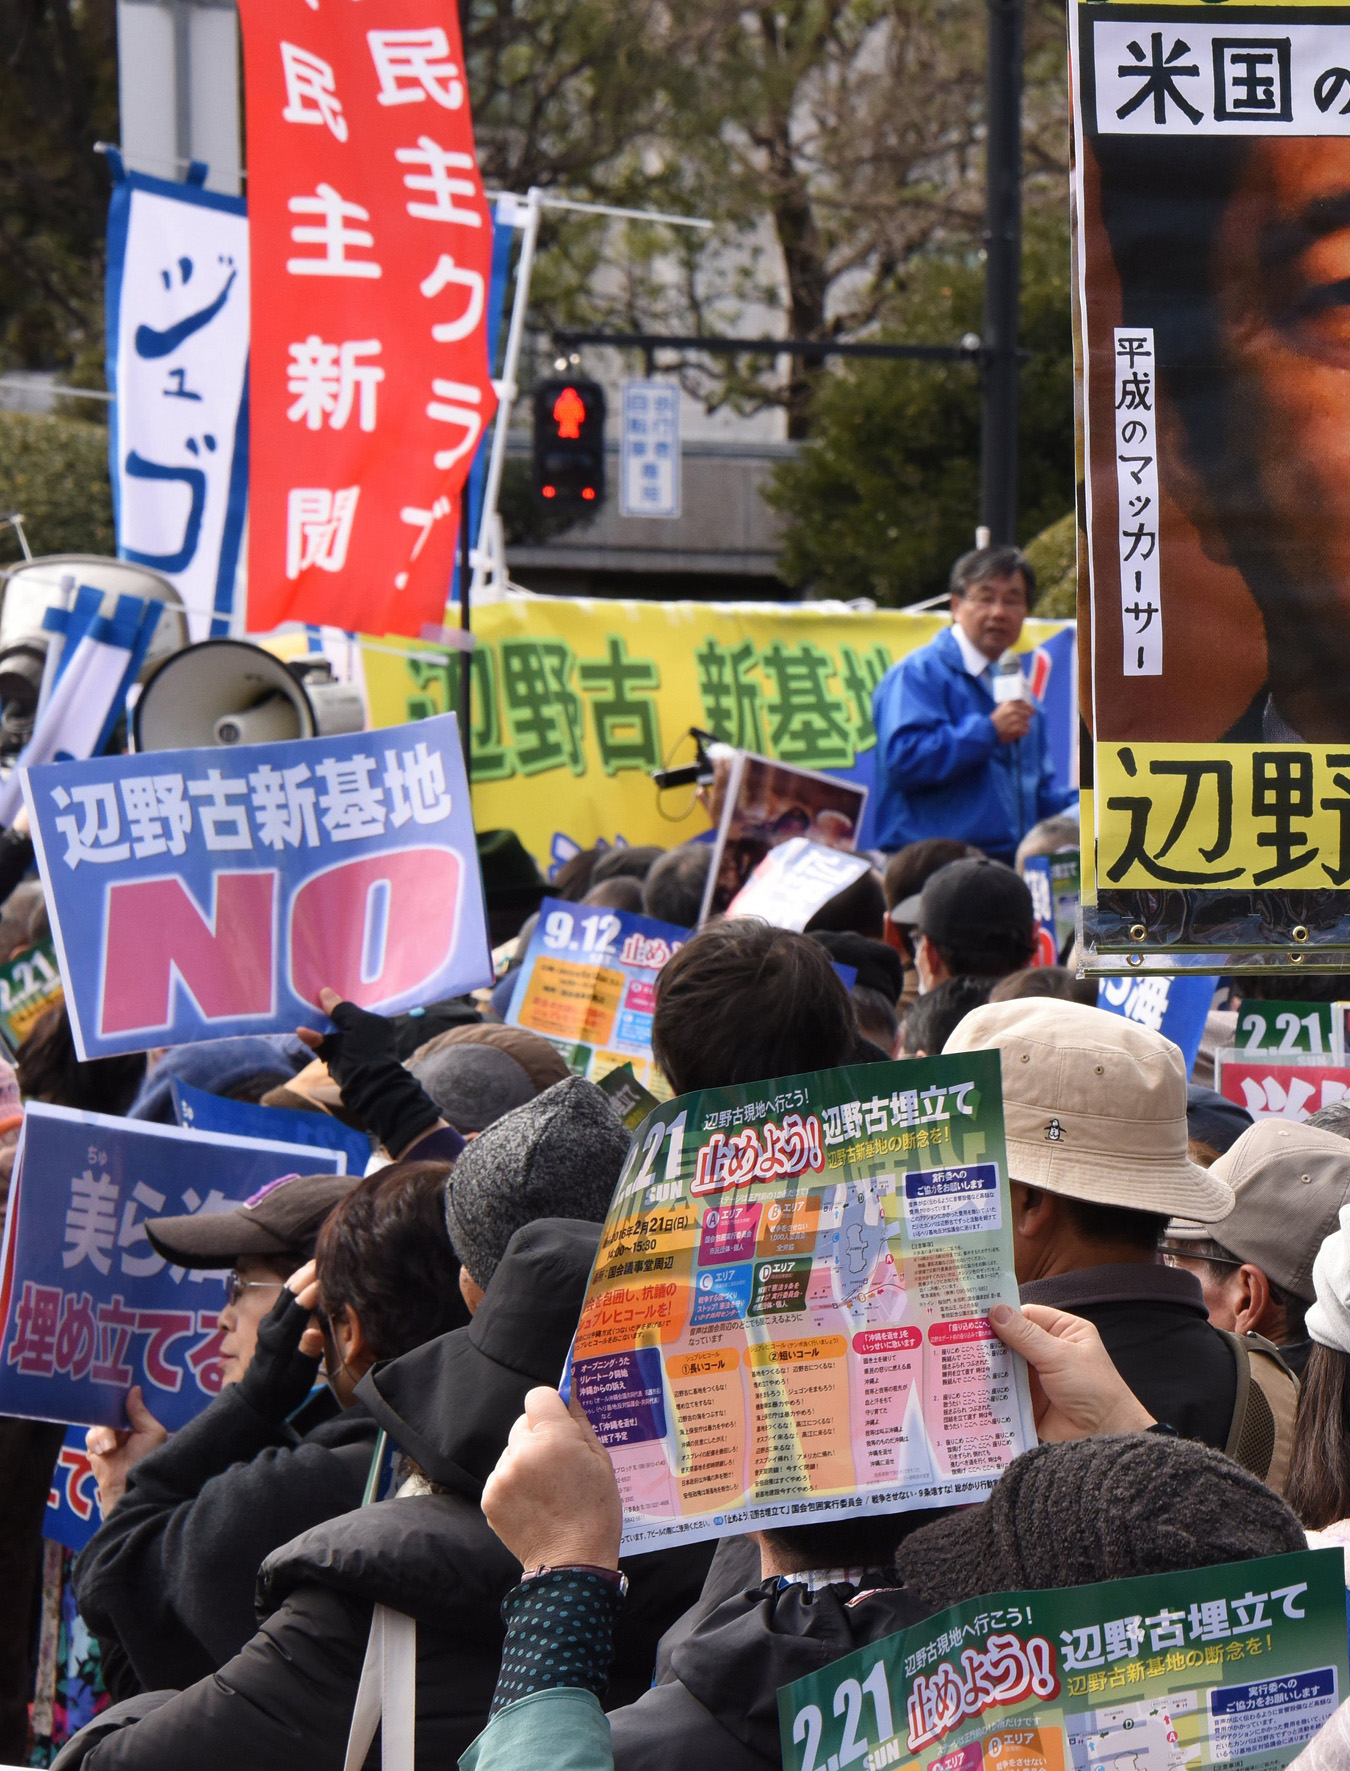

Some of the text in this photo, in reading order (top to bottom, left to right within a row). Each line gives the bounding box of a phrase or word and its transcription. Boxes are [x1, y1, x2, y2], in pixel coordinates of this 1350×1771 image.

[279, 41, 385, 579] 民主新聞
[366, 27, 484, 590] 民主クラブ
[1114, 336, 1160, 670] 平成のマッカーサー
[405, 635, 663, 782] 辺野古
[50, 742, 454, 870] 辺野古新基地
[97, 844, 466, 1039] NO
[543, 911, 623, 954] 9.12
[1242, 1011, 1323, 1056] 2.21
[703, 1088, 809, 1131] 辺野古現地へ行こう!
[821, 1081, 975, 1146] 辺野古埋立て
[827, 1128, 950, 1170] 辺野古新基地の断念を!
[644, 1180, 682, 1206] SUN
[783, 1202, 804, 1212] エリア
[917, 1179, 985, 1195] ご協力をお願いします
[721, 1208, 743, 1219] エリア
[715, 1270, 735, 1281] エリア
[773, 1262, 795, 1272] エリア
[688, 1335, 723, 1346] なっています
[904, 1606, 1033, 1678] 辺野古現地へ行こう!
[1059, 1582, 1308, 1672] 辺野古埋立て
[1068, 1635, 1273, 1698] 辺野古新基地の断念を!
[1249, 1679, 1297, 1697] 実行委への
[906, 1632, 1060, 1754] 止めよう!
[1226, 1686, 1320, 1712] ご協力をお願いします
[793, 1660, 894, 1771] 2.21
[863, 1738, 900, 1771] SUN
[945, 1752, 964, 1768] エリア
[1004, 1733, 1034, 1745] エリア
